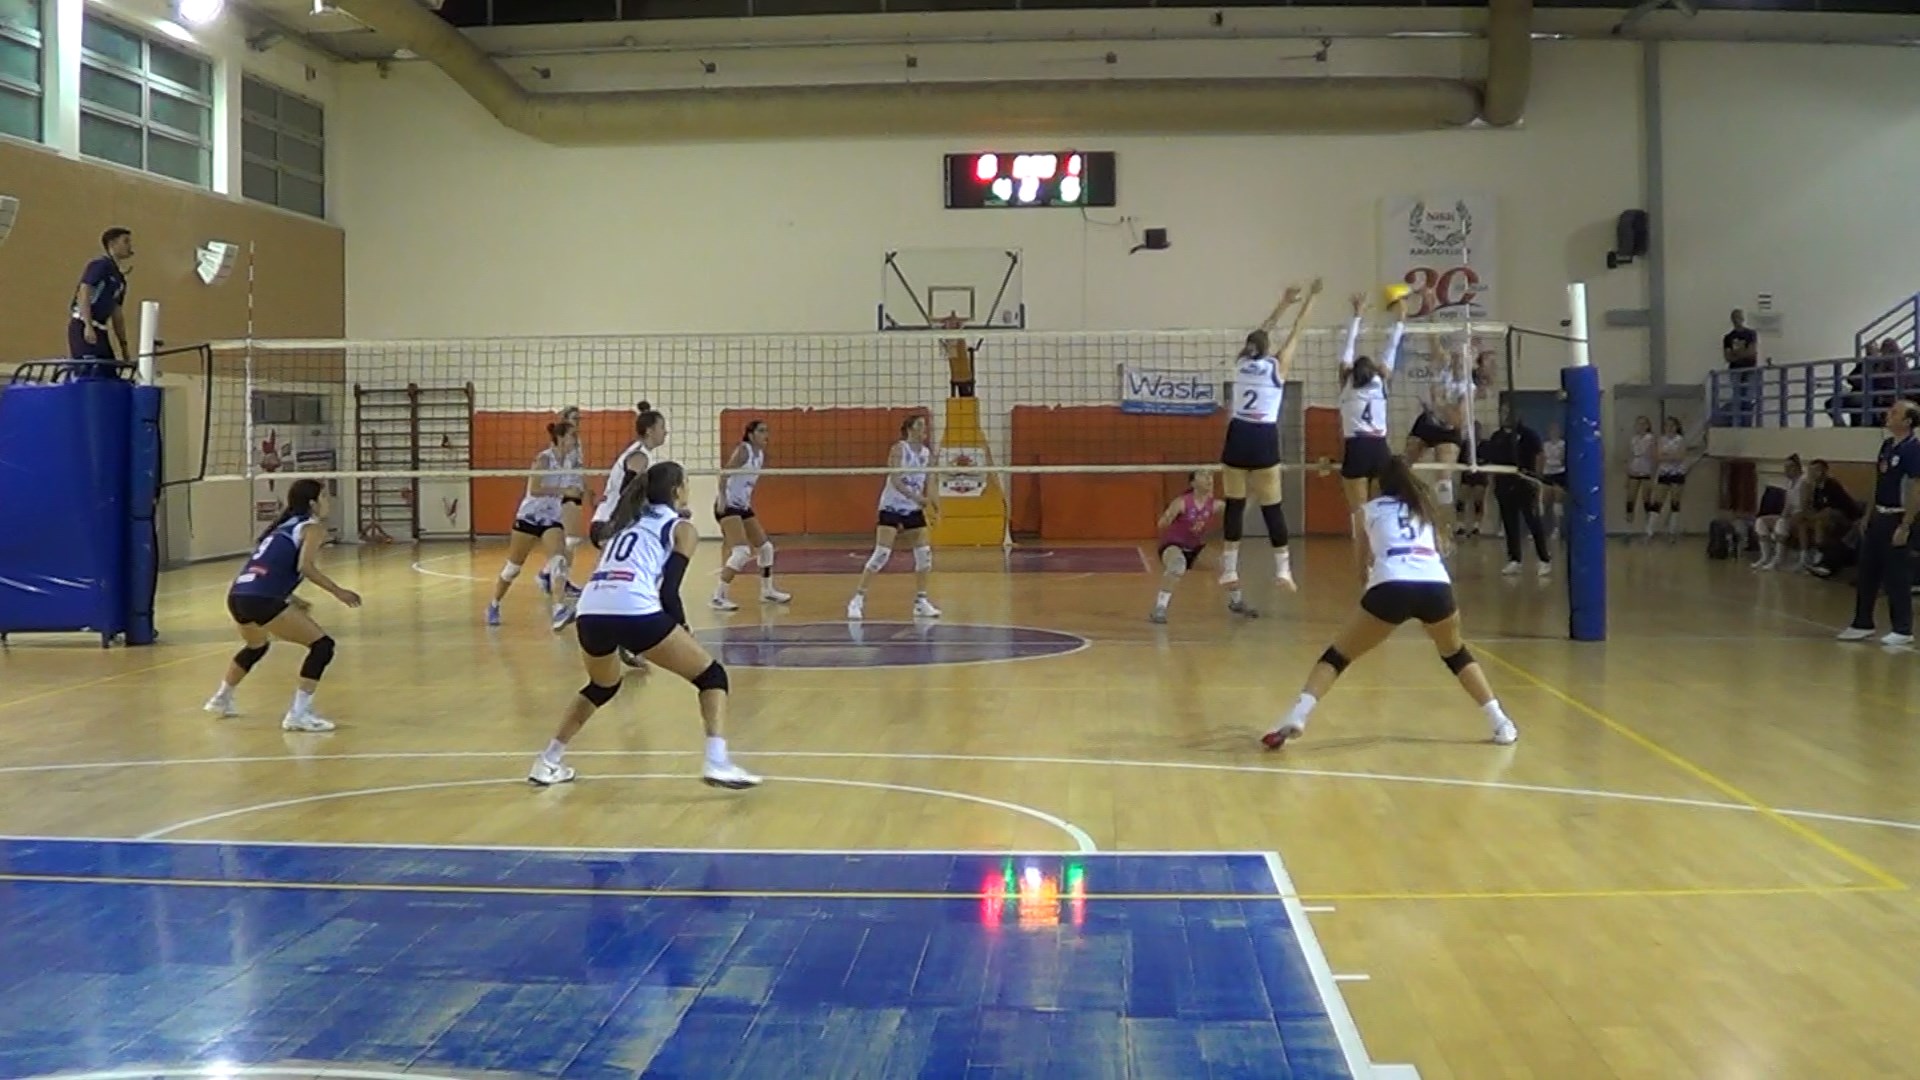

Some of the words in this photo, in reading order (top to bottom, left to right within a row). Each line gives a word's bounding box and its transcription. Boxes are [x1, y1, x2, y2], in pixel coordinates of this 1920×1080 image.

[1242, 389, 1258, 410] 2
[1361, 401, 1373, 424] 4
[1398, 517, 1416, 541] 5
[606, 531, 640, 562] 10
